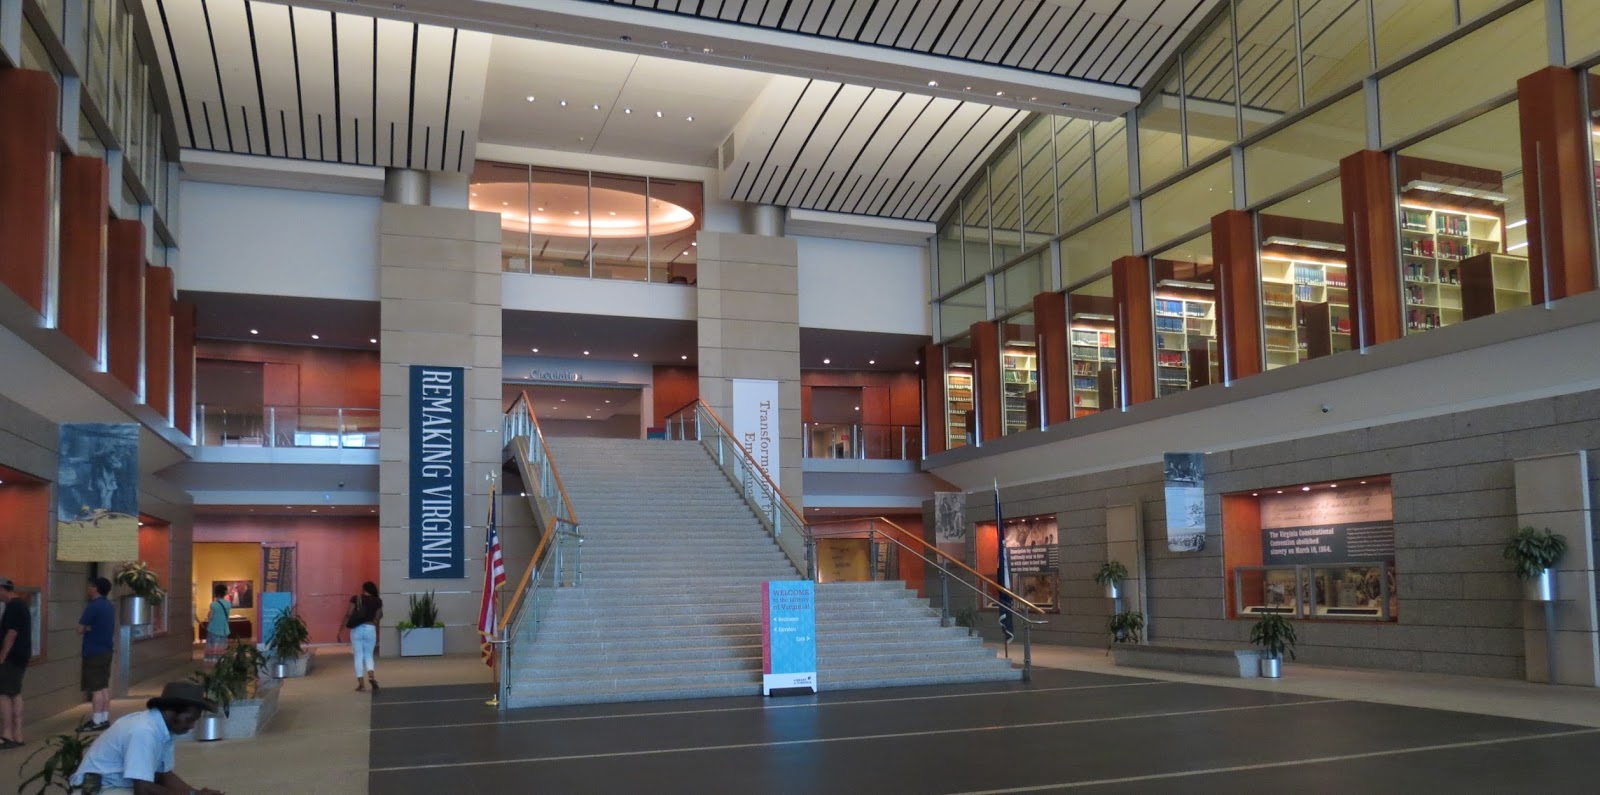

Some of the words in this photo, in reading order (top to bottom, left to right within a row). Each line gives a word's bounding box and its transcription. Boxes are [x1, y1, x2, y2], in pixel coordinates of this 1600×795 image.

[530, 368, 583, 381] Circulation
[421, 370, 452, 478] REMAKING
[421, 486, 452, 574] VIRGINIA
[1280, 530, 1298, 538] Virginia
[1299, 528, 1334, 537] Constitutional
[1270, 539, 1295, 547] Convention
[1270, 548, 1287, 556] slavery
